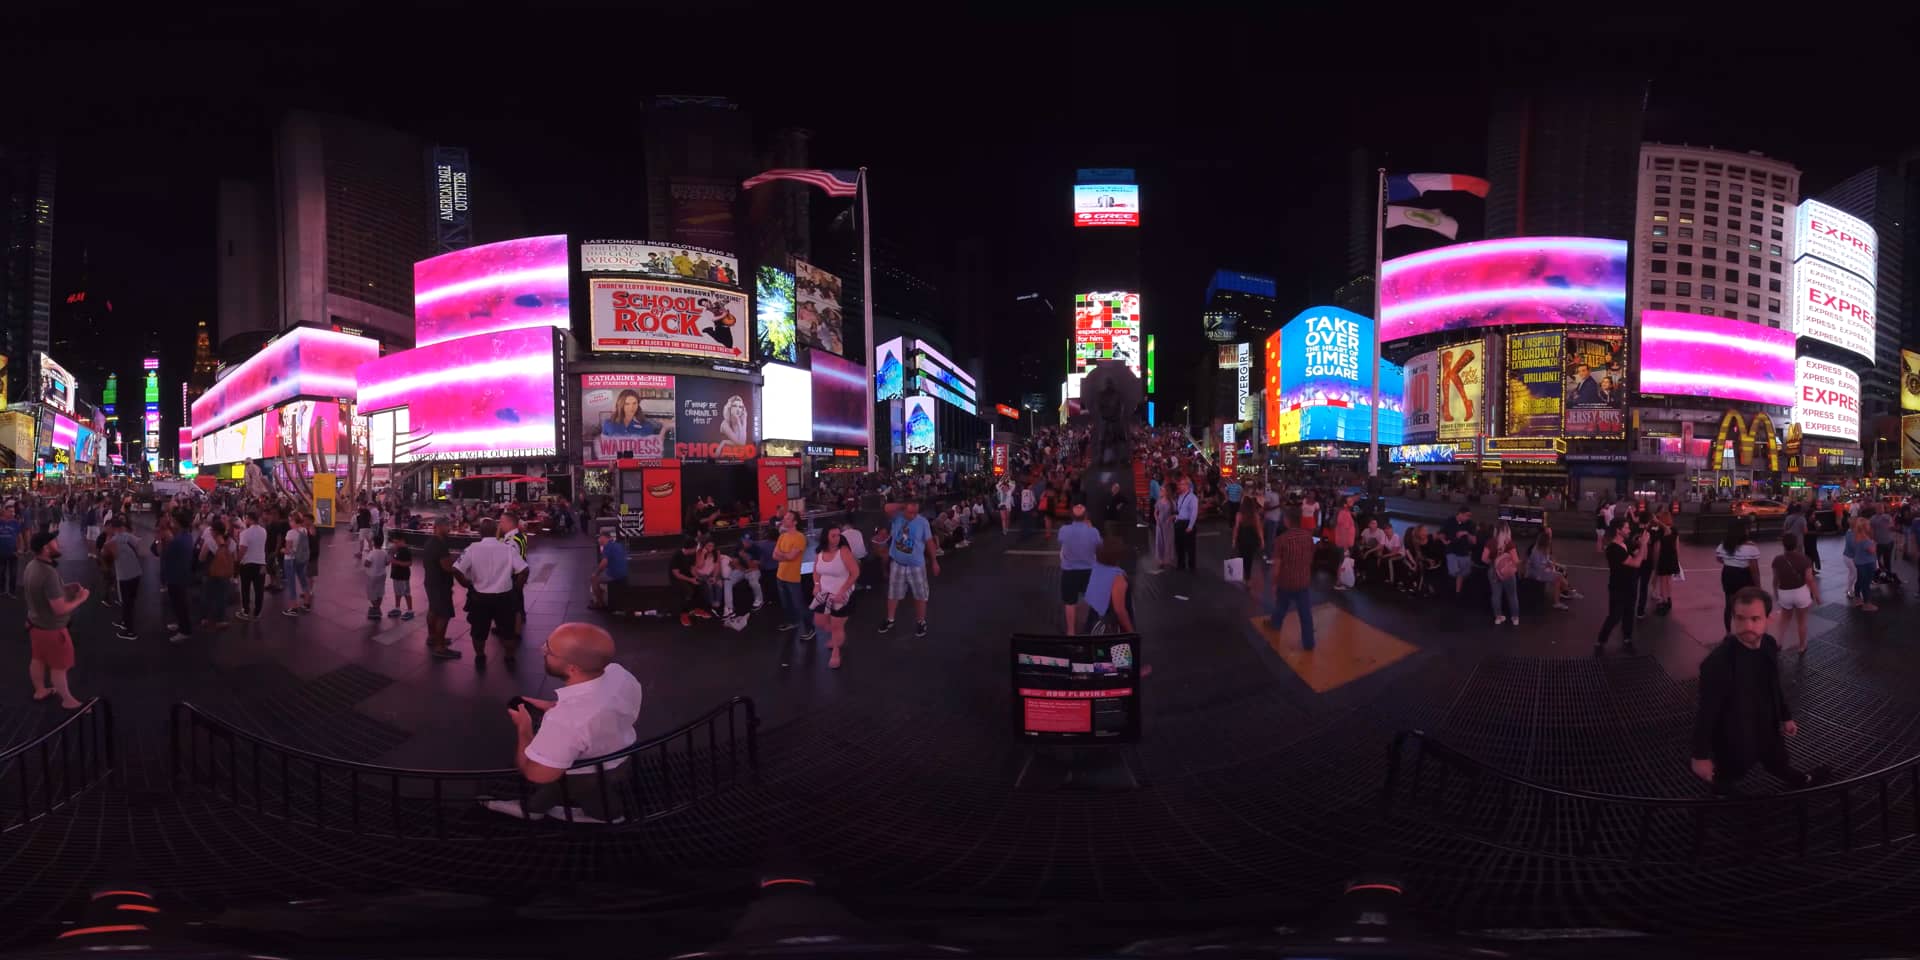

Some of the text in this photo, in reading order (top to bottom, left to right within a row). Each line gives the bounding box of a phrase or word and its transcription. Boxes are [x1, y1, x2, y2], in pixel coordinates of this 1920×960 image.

[453, 172, 468, 211] OUTFITTERS
[440, 183, 453, 221] AMERICAN
[671, 243, 707, 252] CLOTHES
[585, 257, 640, 266] WRONG
[612, 291, 703, 313] SCHOOL
[614, 309, 704, 337] ROCK
[1305, 316, 1359, 338] TAKE
[1077, 328, 1113, 336] especially
[1305, 331, 1359, 352] OVER
[1512, 339, 1523, 350] AN
[1524, 335, 1560, 348] INSPIRED
[1306, 345, 1320, 353] THE
[1321, 345, 1348, 354] HEART
[1512, 346, 1560, 361] BROADWAY
[1305, 351, 1359, 370] TIMES
[1806, 360, 1842, 376] EXPRESS
[1305, 365, 1359, 381] SQUARE
[1523, 371, 1560, 384] BRILLIANT!
[1803, 372, 1835, 386] XPRESS
[1239, 349, 1249, 414] COVERGIRL
[1567, 409, 1597, 424] JERSEY
[1802, 407, 1834, 420] XPRESS
[1805, 421, 1841, 434] EXPRESS
[600, 438, 661, 456] WAITRESS
[1819, 447, 1844, 455] EXPRESS
[410, 447, 556, 463] AMERICAN EAGLE OUTFITTERS
